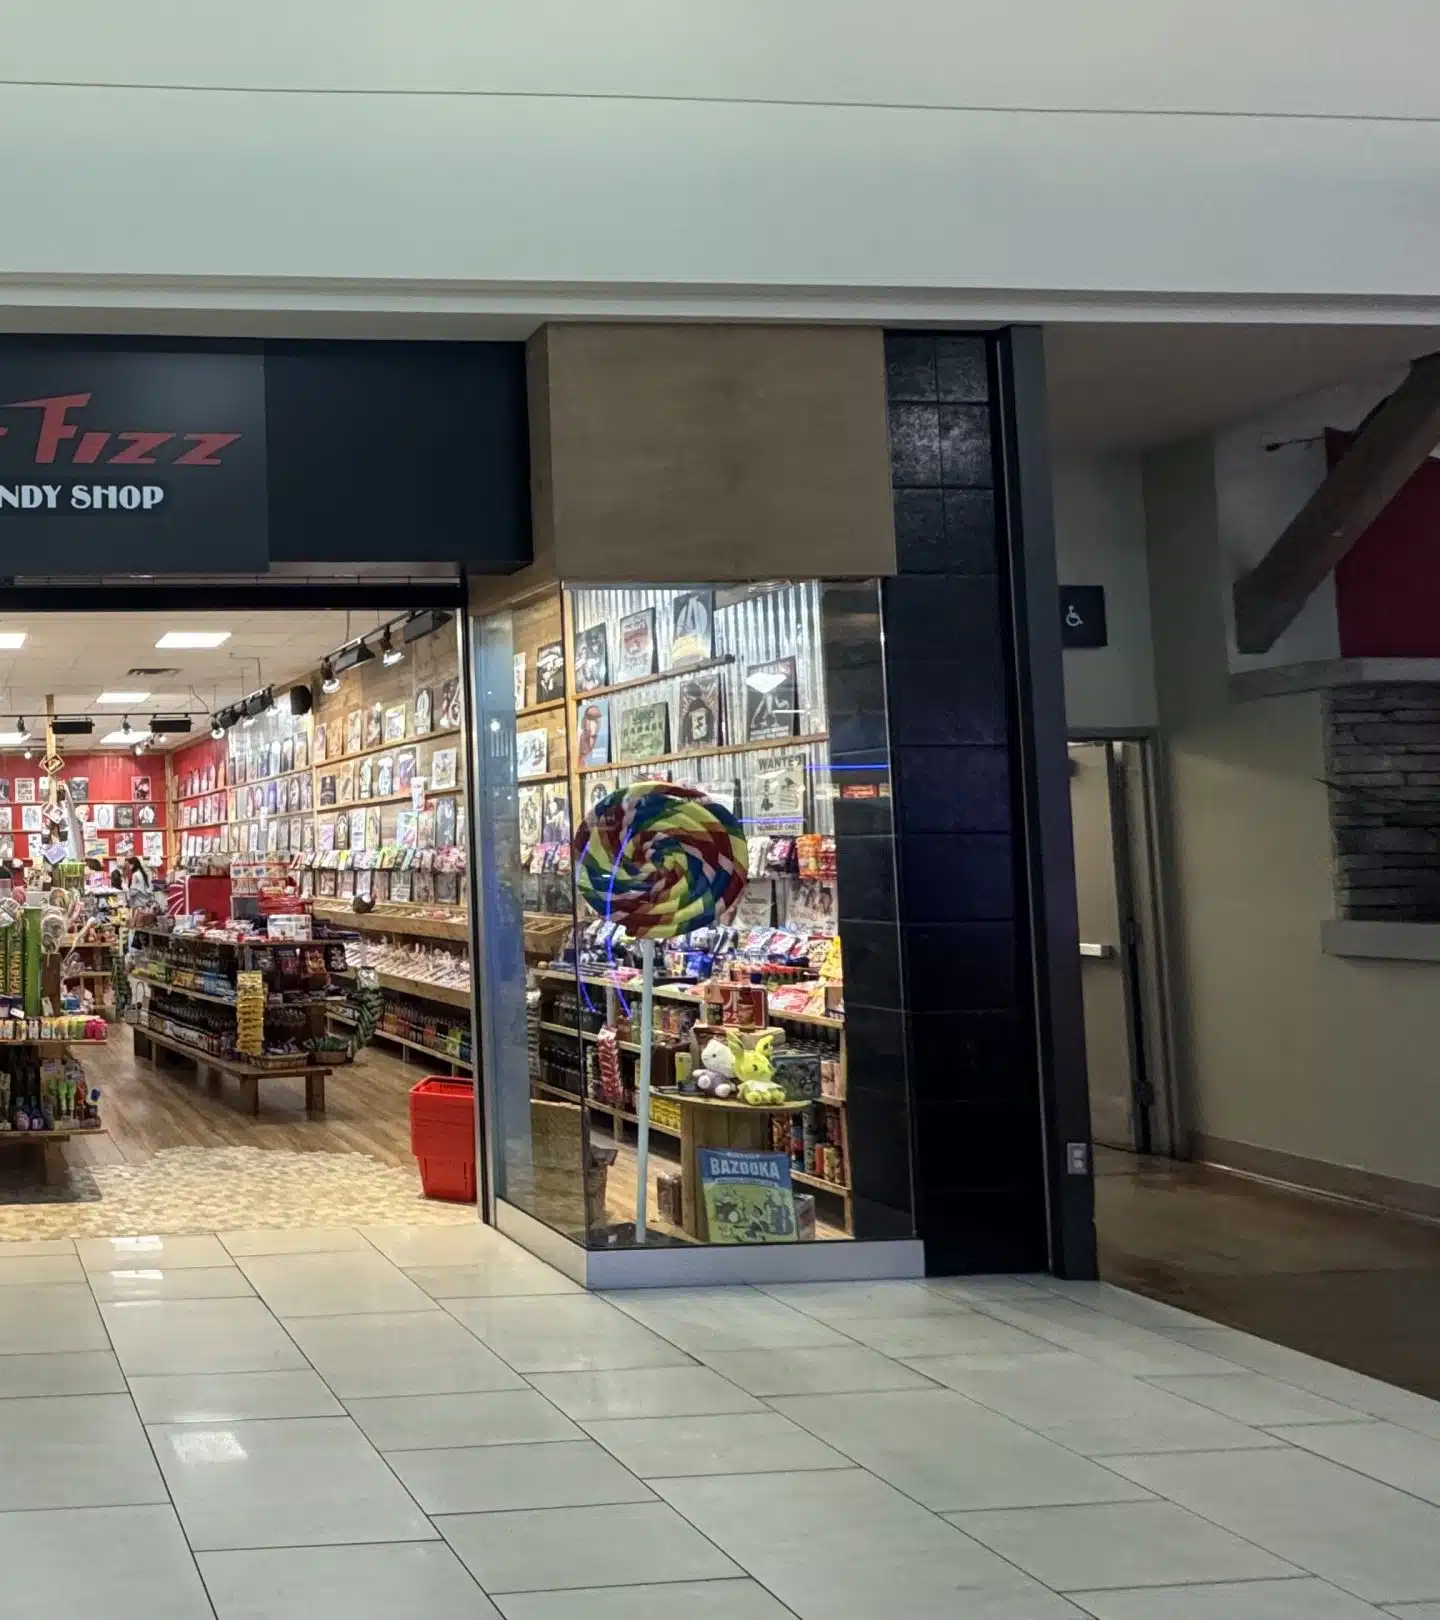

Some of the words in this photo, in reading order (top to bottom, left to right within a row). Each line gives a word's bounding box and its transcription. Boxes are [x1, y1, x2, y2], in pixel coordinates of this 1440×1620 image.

[0, 392, 243, 466] FIZZ
[70, 485, 165, 510] SHOP
[710, 1157, 780, 1180] BAZOOKA
